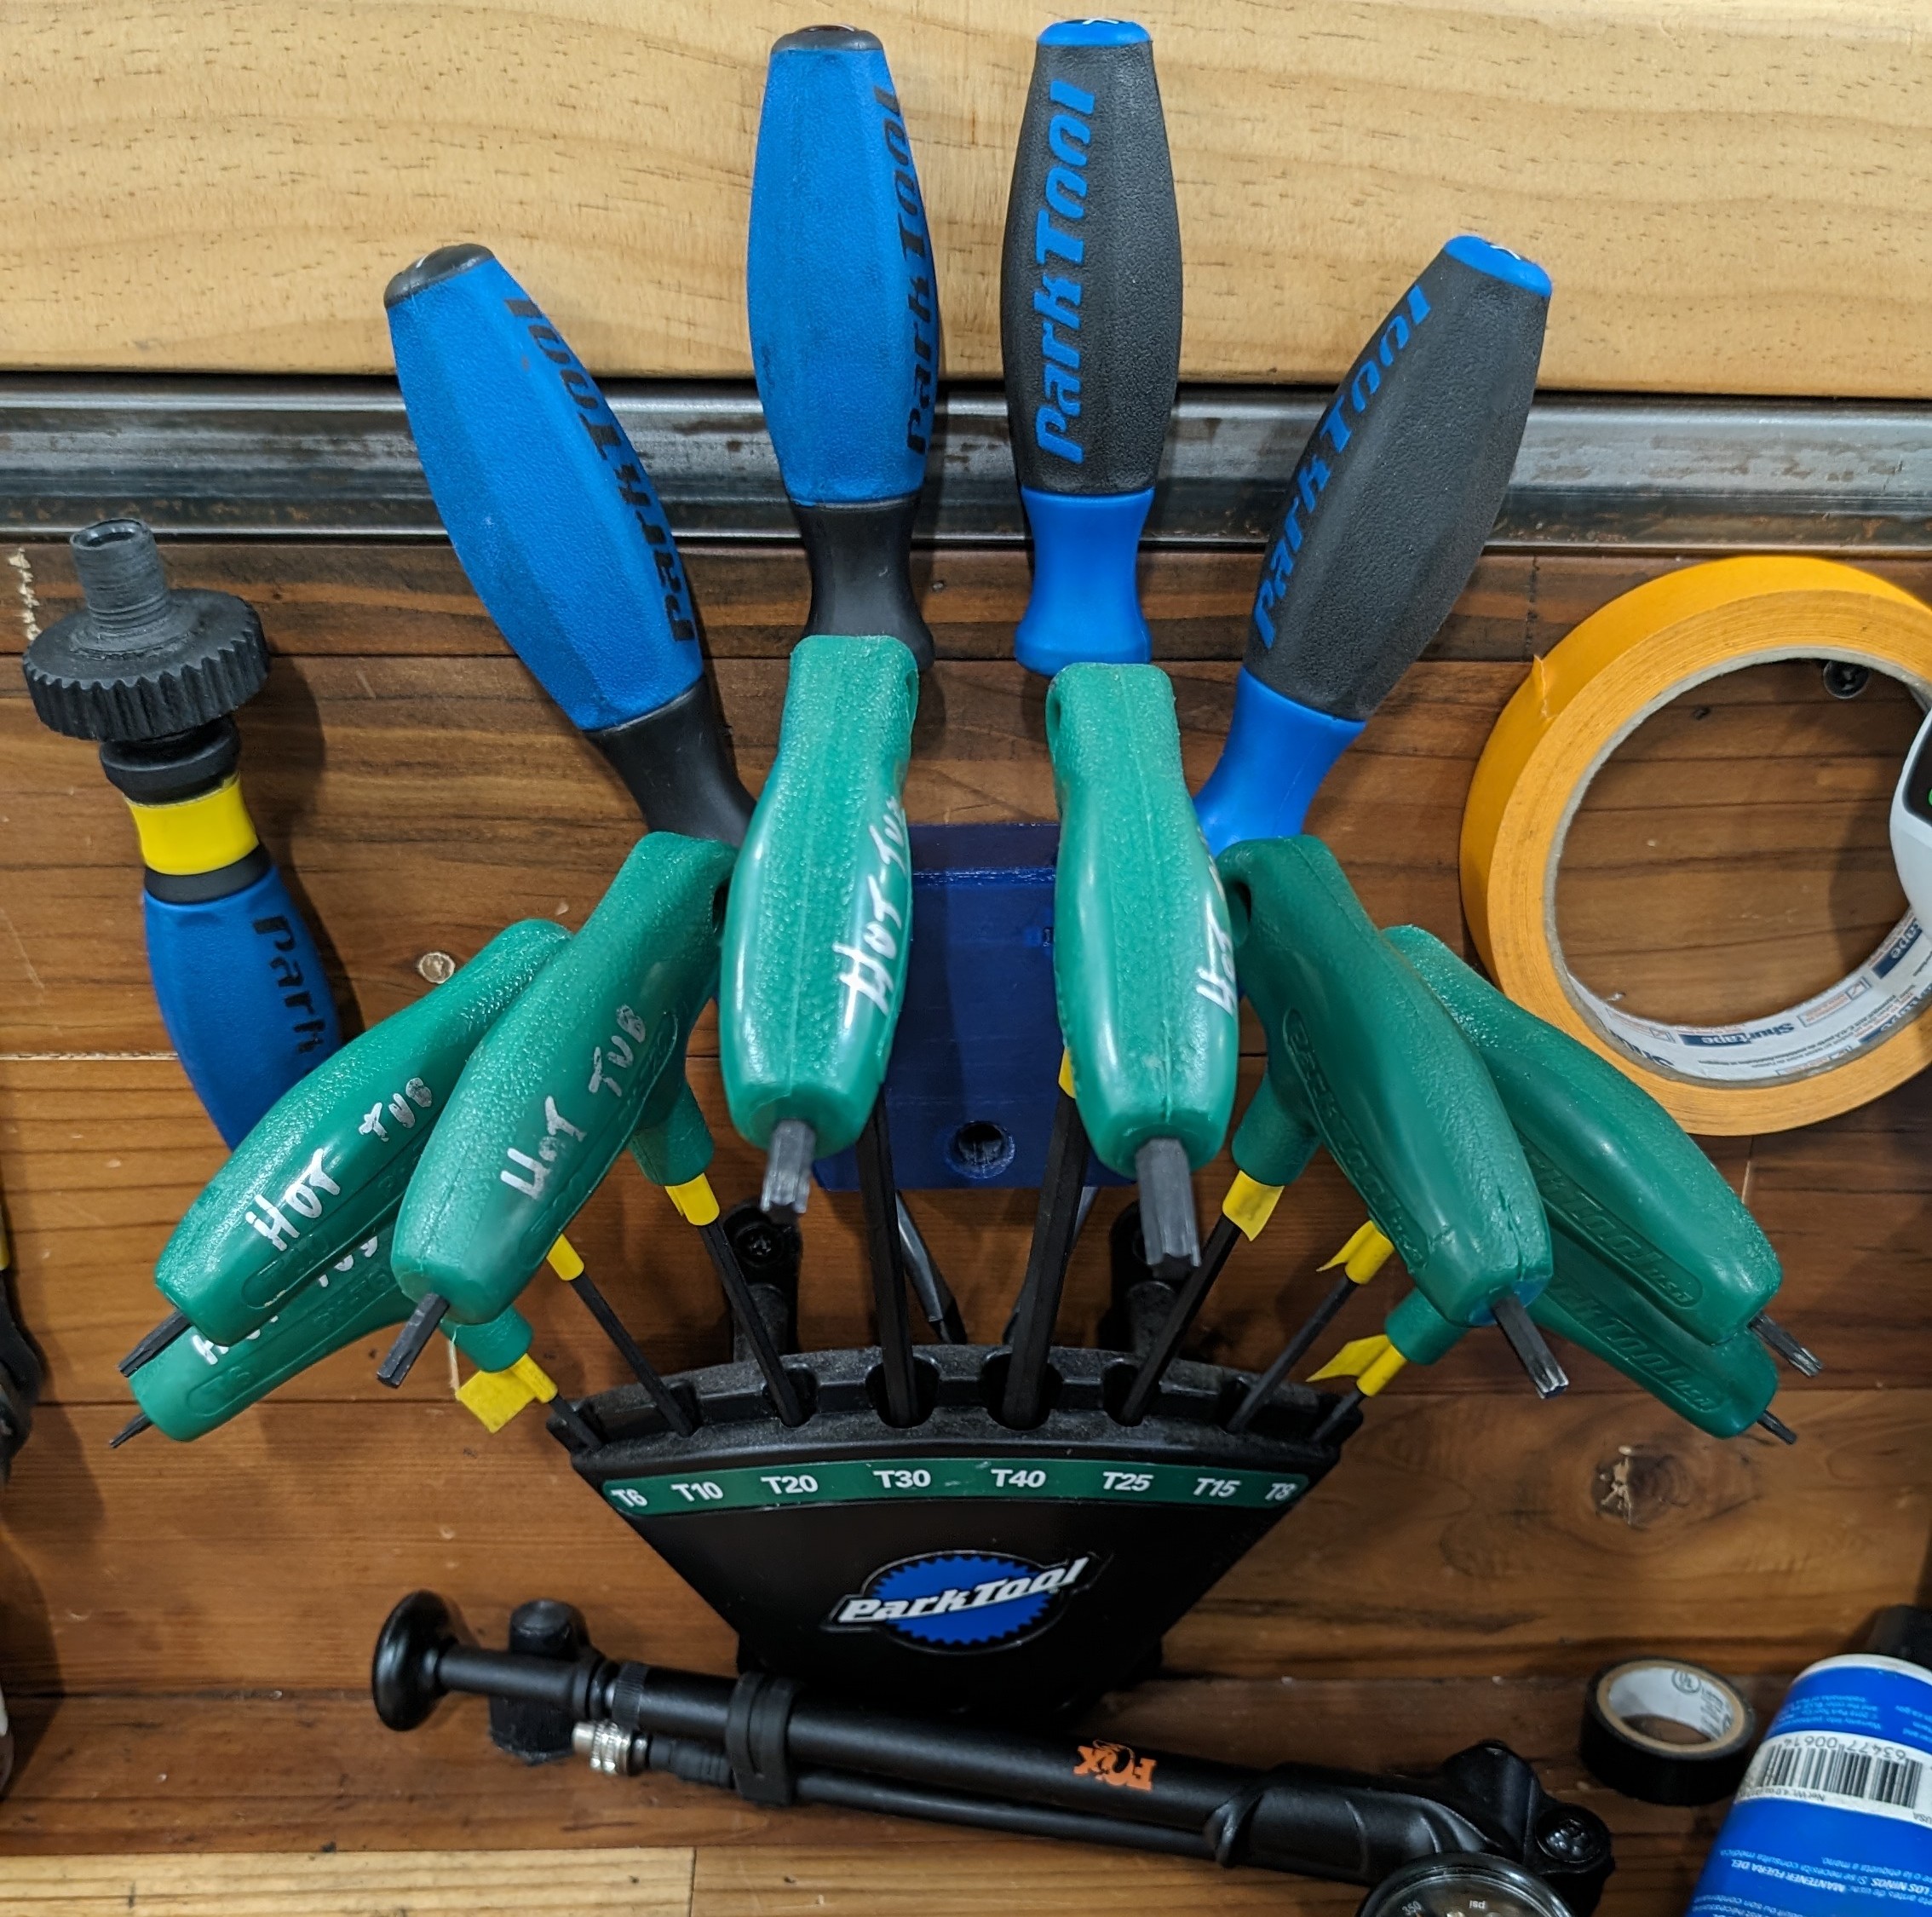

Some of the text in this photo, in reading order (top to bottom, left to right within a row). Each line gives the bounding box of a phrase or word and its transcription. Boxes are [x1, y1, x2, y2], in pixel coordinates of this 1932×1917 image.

[874, 85, 932, 456] ParkTool
[1033, 79, 1095, 465] ParkTool
[504, 298, 697, 642] ParkTool
[1254, 284, 1431, 650] ParkTool
[832, 874, 902, 1017] HOT
[1700, 1022, 1795, 1047] Shurtape
[245, 1148, 342, 1252] HOT
[610, 1468, 1297, 1508] T6 T10 T20 T30 T40 T25 T15 T8
[838, 1557, 1090, 1623] ParkTool
[1073, 1740, 1157, 1791] FOX
[1401, 1900, 1422, 1916] 350
[1469, 1899, 1486, 1909] psi
[1731, 1857, 1847, 1894] MANTENER FUERA DEL
